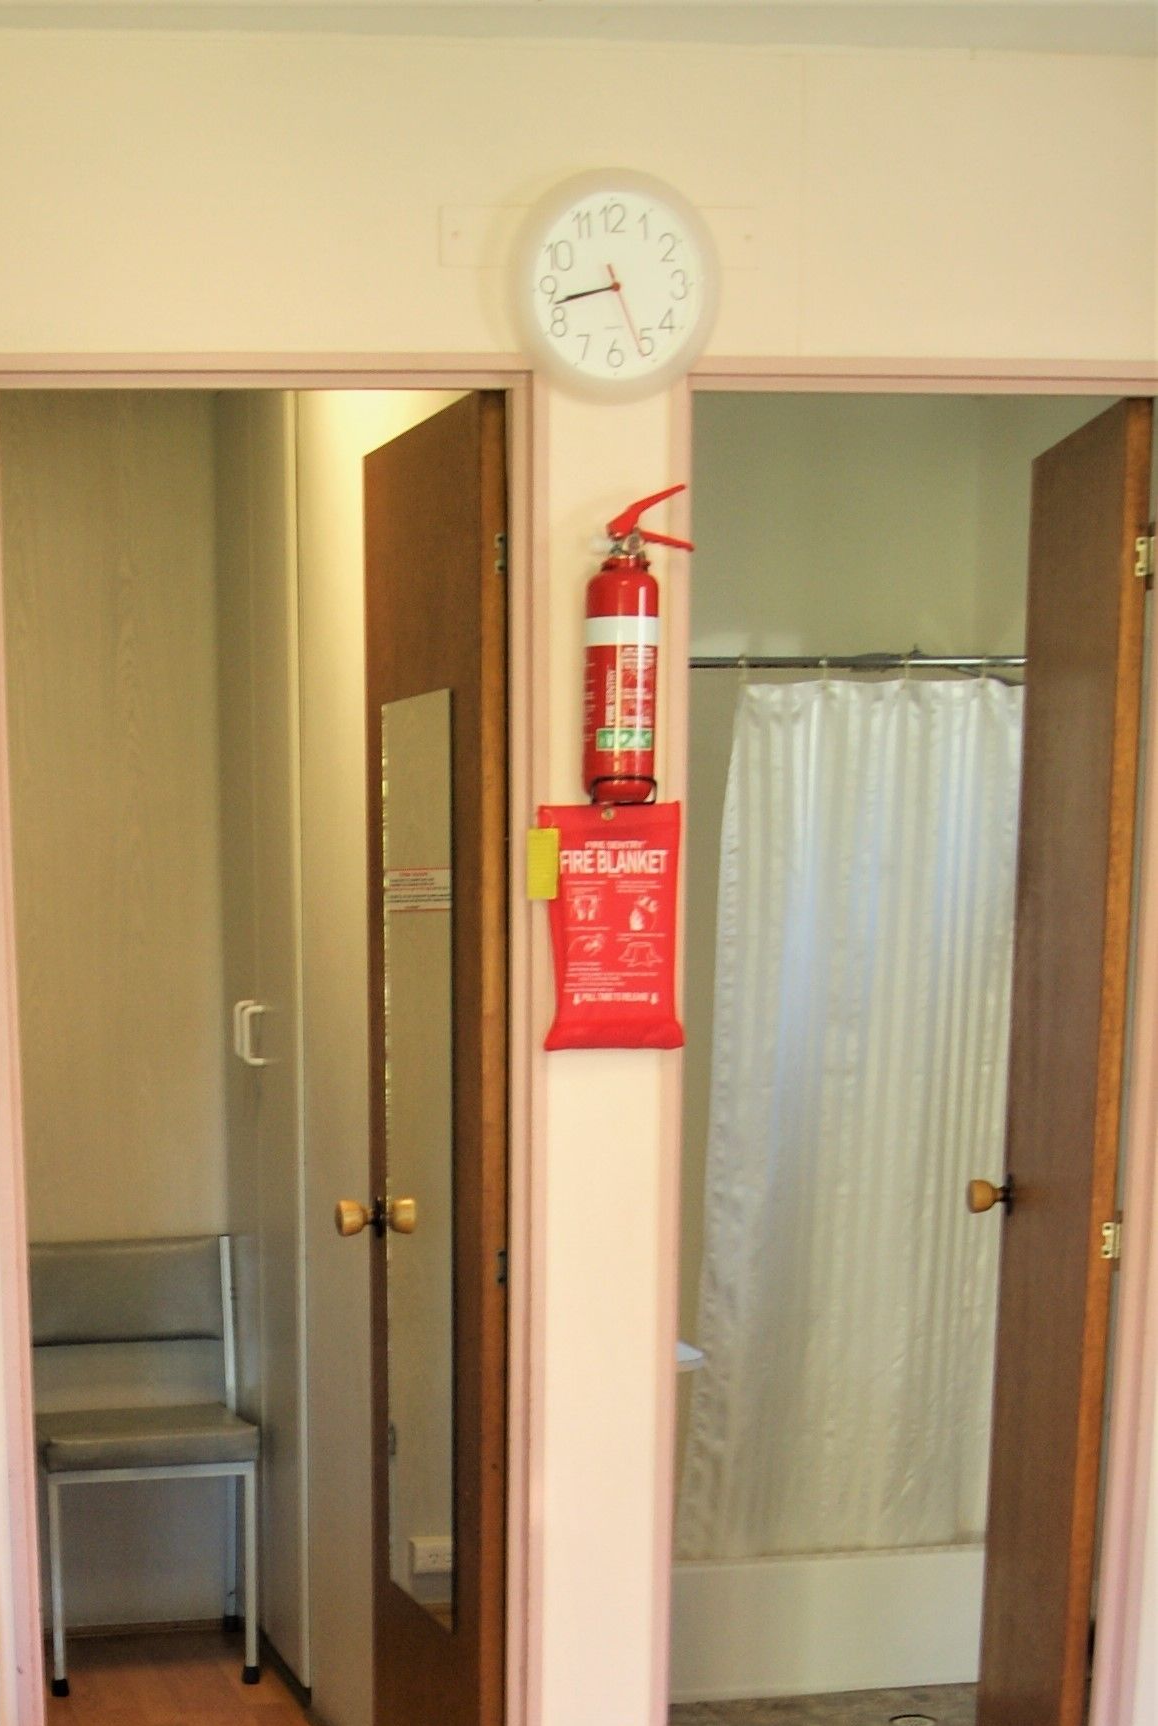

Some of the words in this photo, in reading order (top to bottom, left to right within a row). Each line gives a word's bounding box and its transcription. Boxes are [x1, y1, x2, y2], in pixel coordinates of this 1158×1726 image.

[572, 210, 592, 239] 11
[599, 203, 626, 233] 12
[638, 212, 648, 241] 1
[545, 239, 574, 271] 10
[658, 232, 676, 262] 2
[539, 275, 558, 305] 9
[670, 269, 689, 301] 3
[550, 306, 568, 338] 8
[658, 307, 675, 334] 4
[576, 334, 591, 360] 7
[606, 339, 624, 368] 6
[638, 327, 655, 357] 5
[559, 850, 595, 875] FIRE
[596, 850, 668, 875] BLANKET
